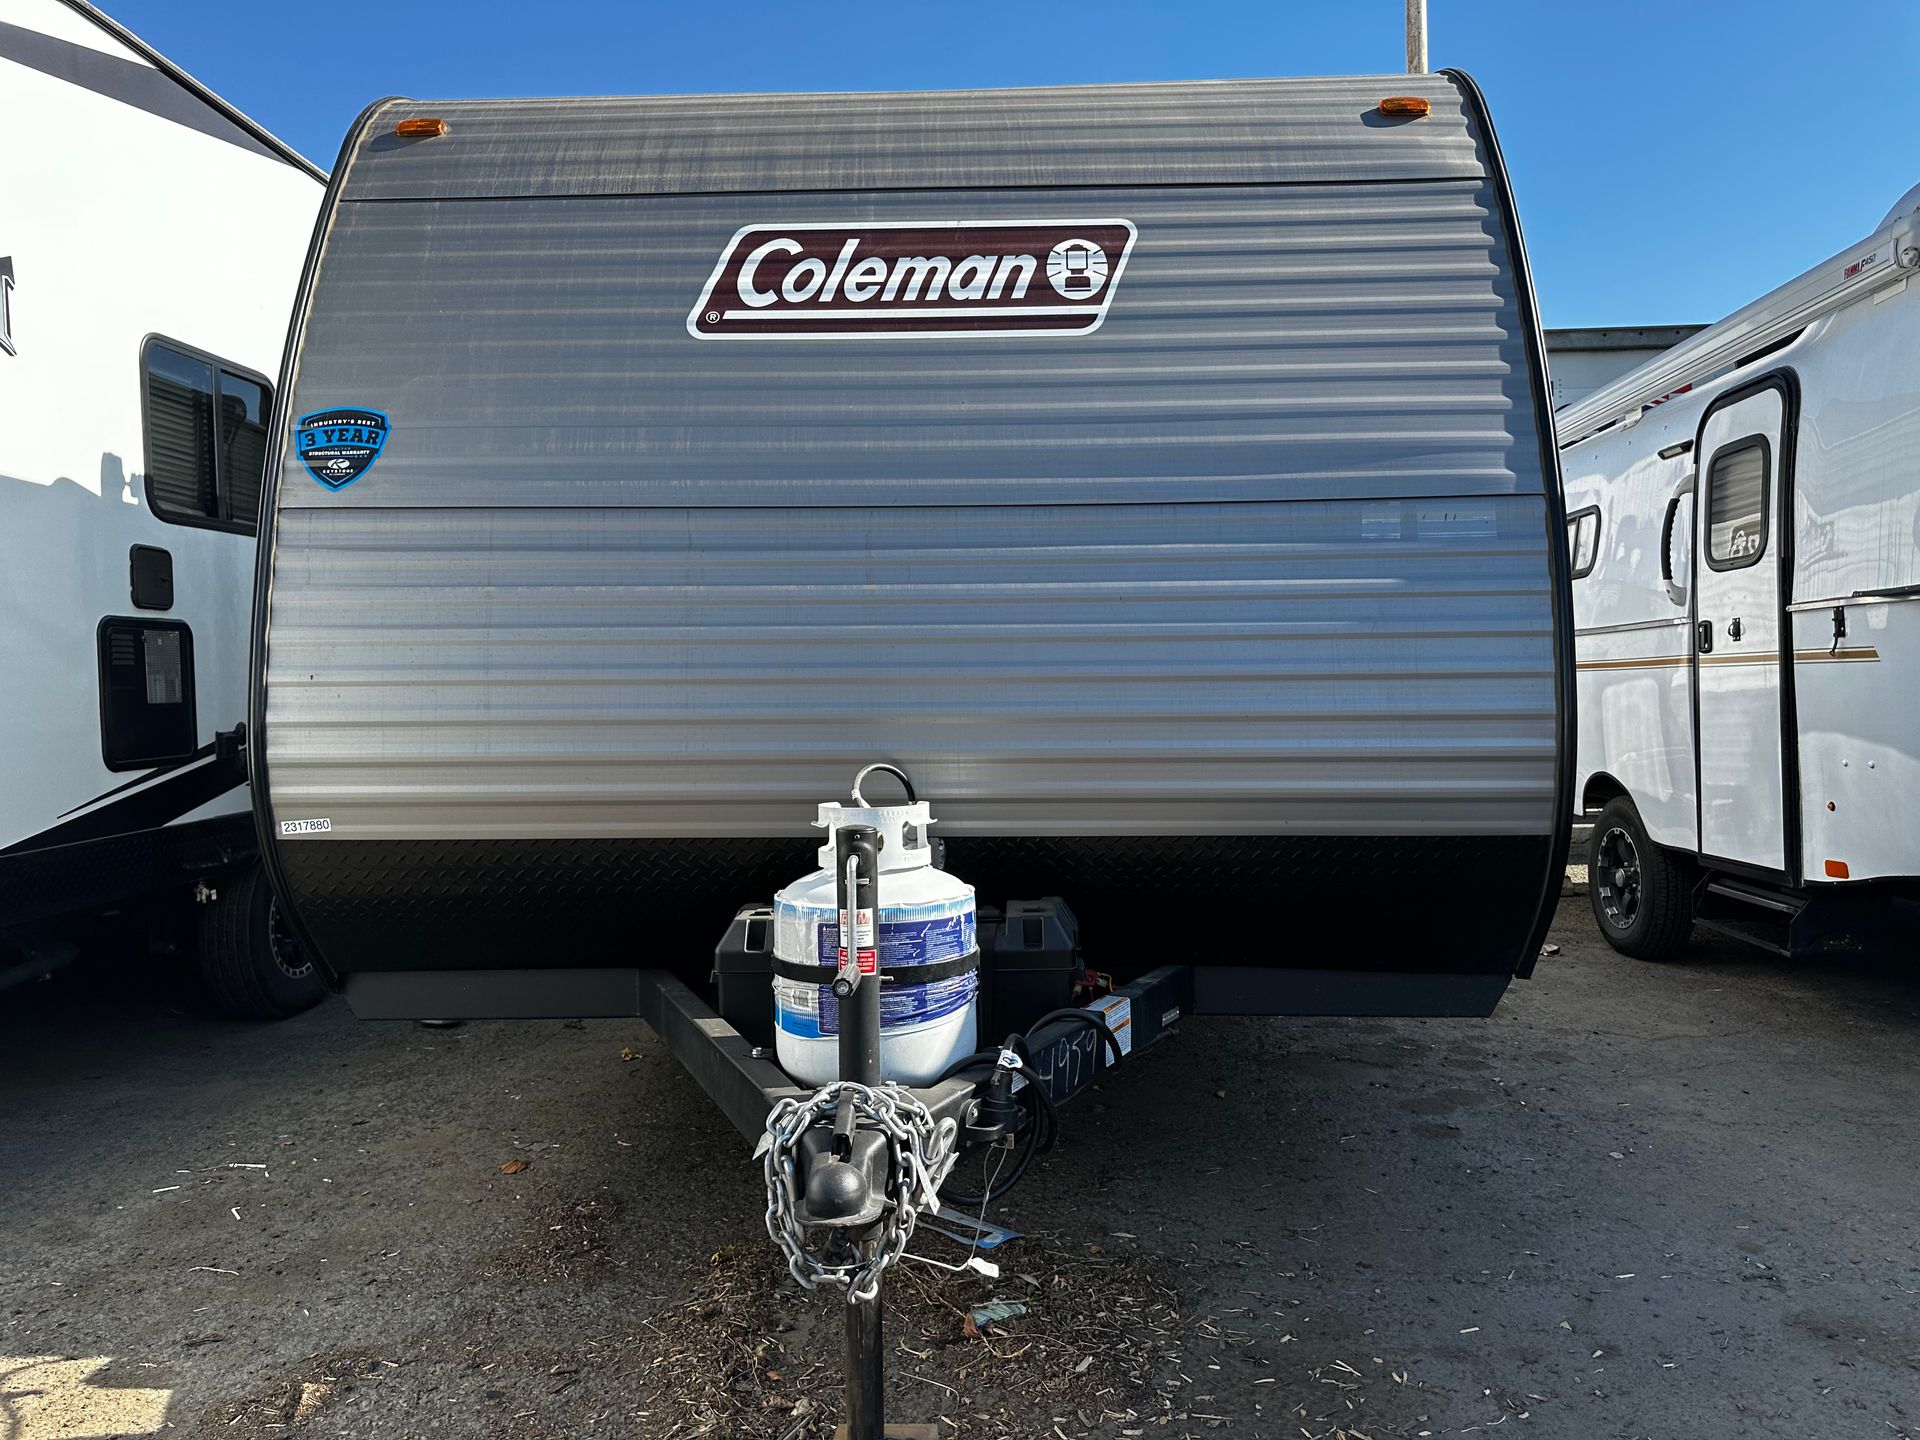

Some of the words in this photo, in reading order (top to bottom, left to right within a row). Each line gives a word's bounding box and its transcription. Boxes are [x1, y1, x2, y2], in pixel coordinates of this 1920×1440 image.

[736, 237, 1038, 308] Coleman
[310, 419, 355, 428] INDUSTRY'S
[304, 432, 316, 447] 3
[322, 428, 380, 445] YEAR
[283, 819, 330, 832] 2317880
[1038, 1028, 1098, 1100] 4959
